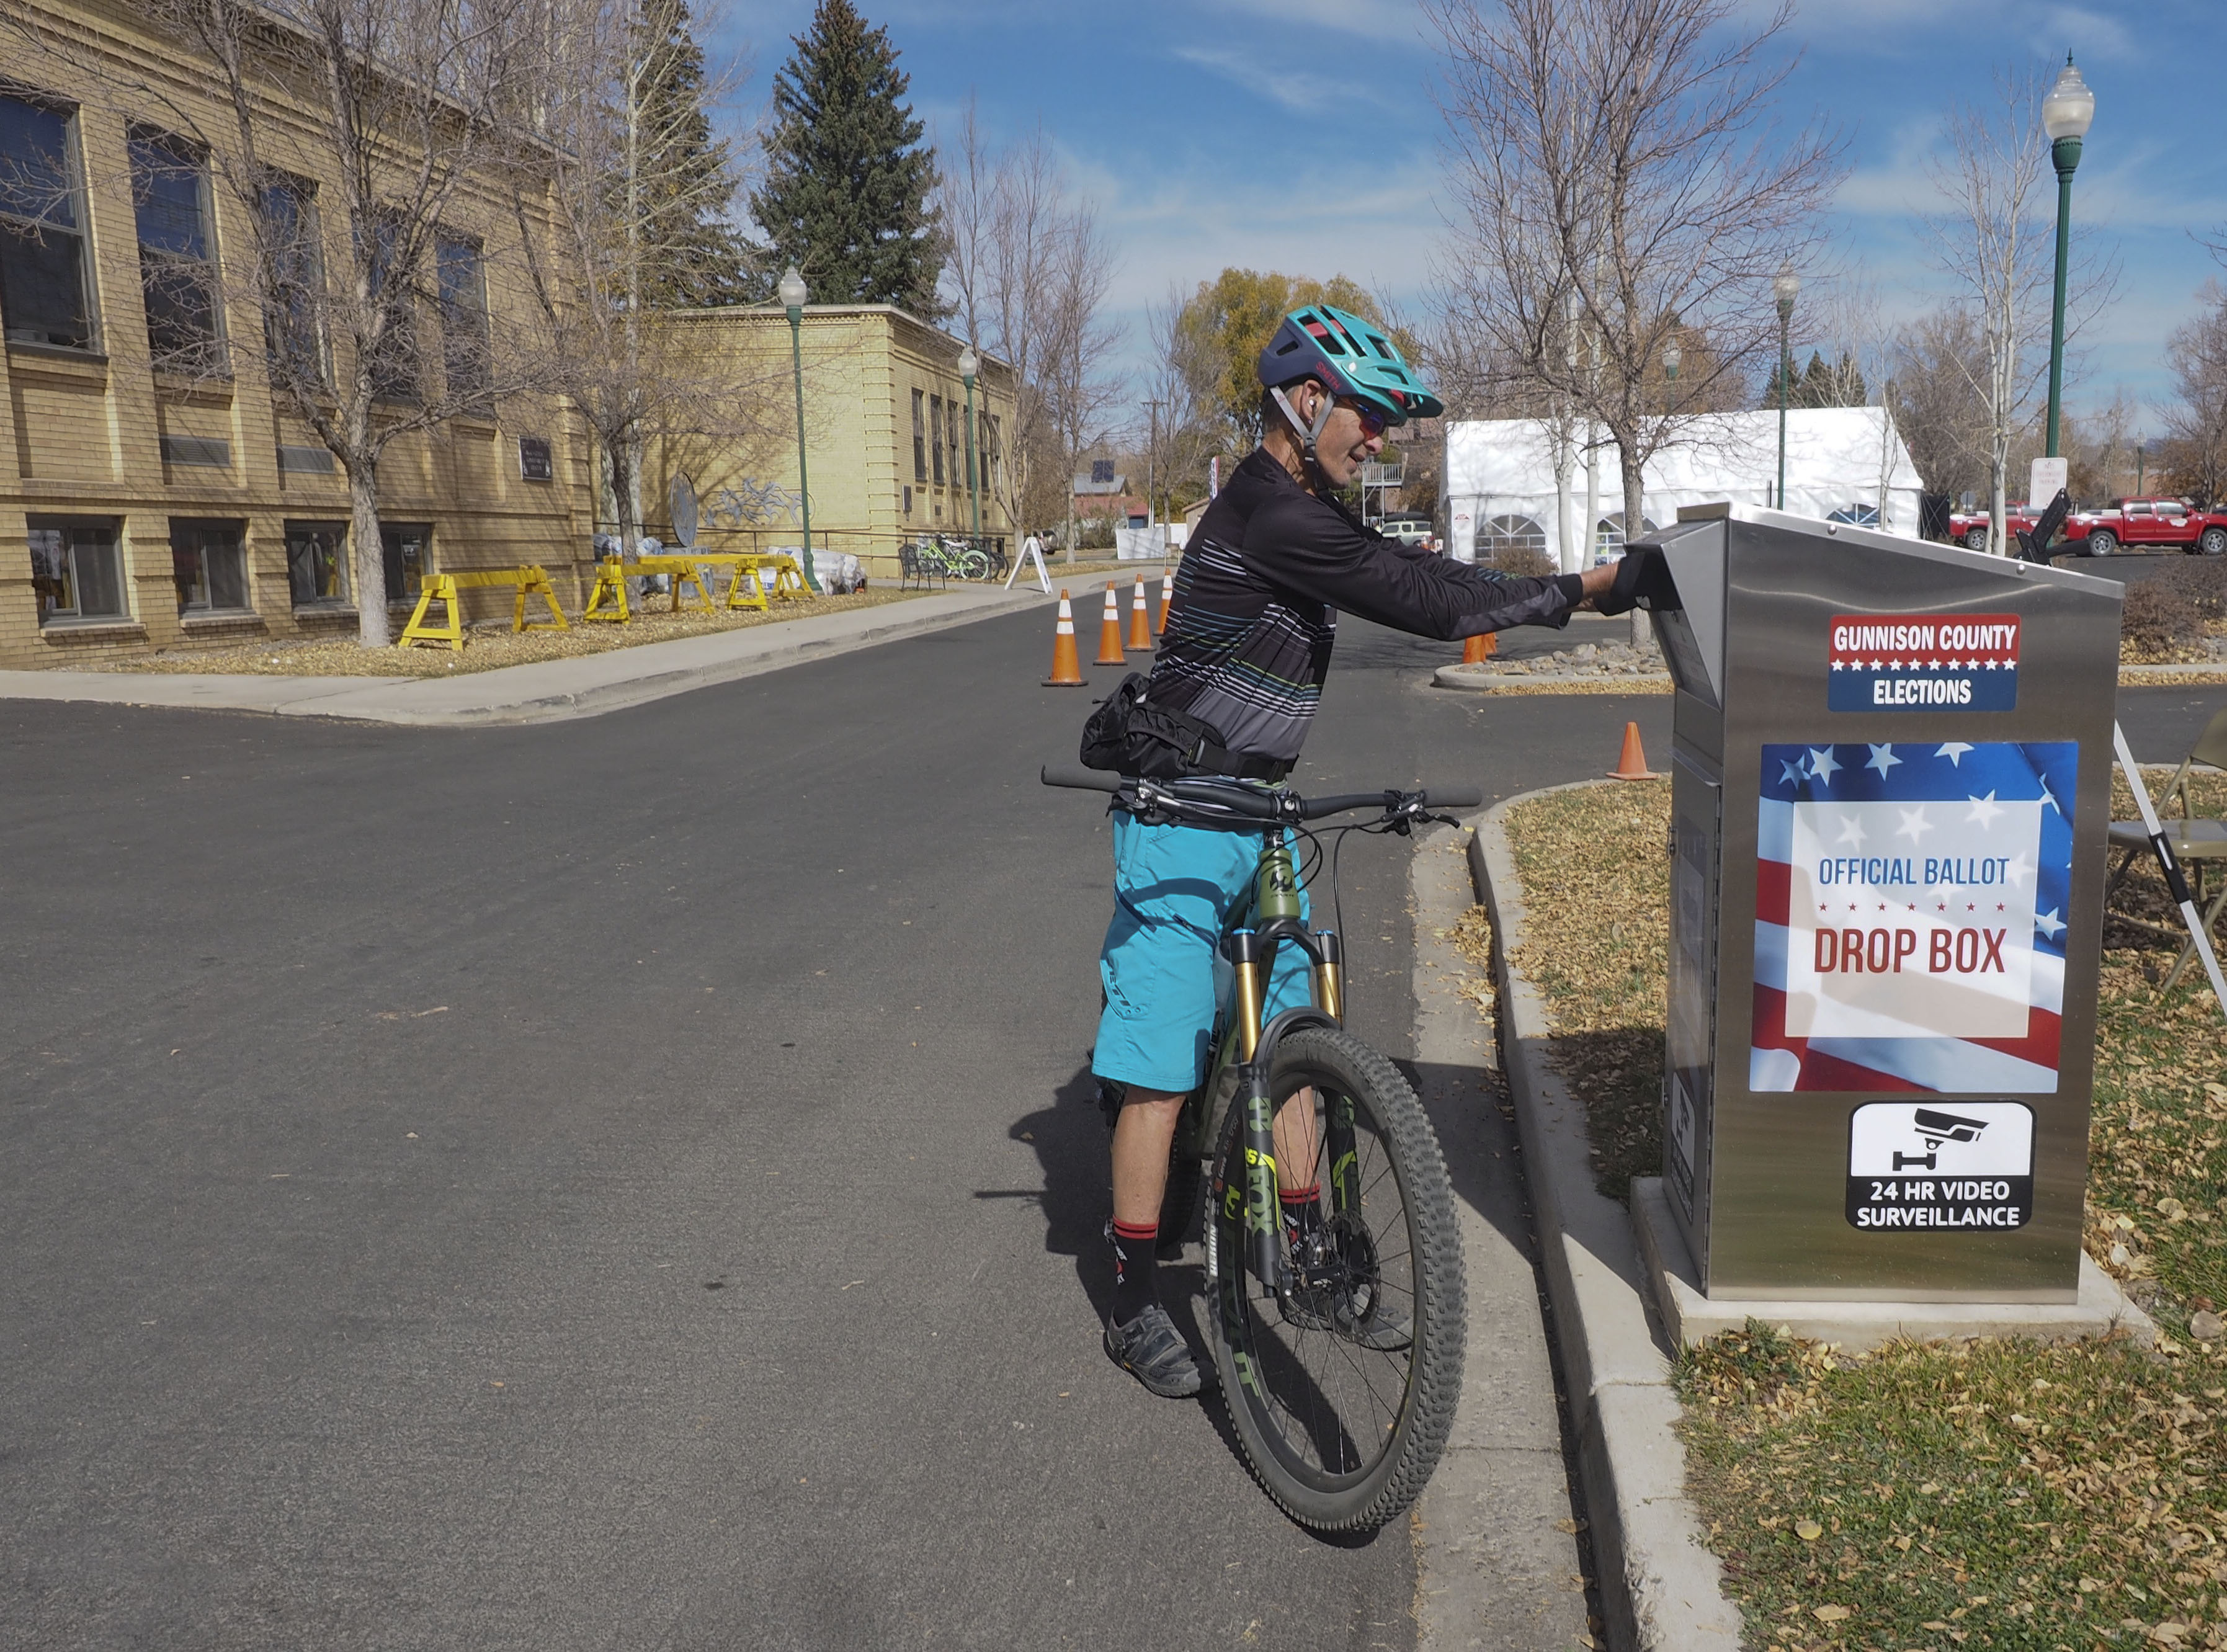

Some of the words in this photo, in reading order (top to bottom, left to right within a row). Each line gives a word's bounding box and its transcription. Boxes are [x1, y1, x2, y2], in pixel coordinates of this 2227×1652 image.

[1316, 361, 1341, 390] SMITH
[1834, 625, 1935, 652] GUNNISON
[1939, 625, 2017, 651] COUNTY
[1873, 679, 1971, 705] ELECTIONS
[1819, 857, 1916, 885] OFFICIAL
[1924, 857, 2011, 885] BALLOT
[1814, 927, 1916, 973] DROP
[1929, 927, 2006, 973] BOX
[1246, 1164, 1274, 1236] FOX
[1870, 1181, 1898, 1202] 24
[1904, 1181, 1935, 1202] HR
[1940, 1181, 2011, 1202] VIDEO
[1857, 1205, 2020, 1228] SURVEILLANCE
